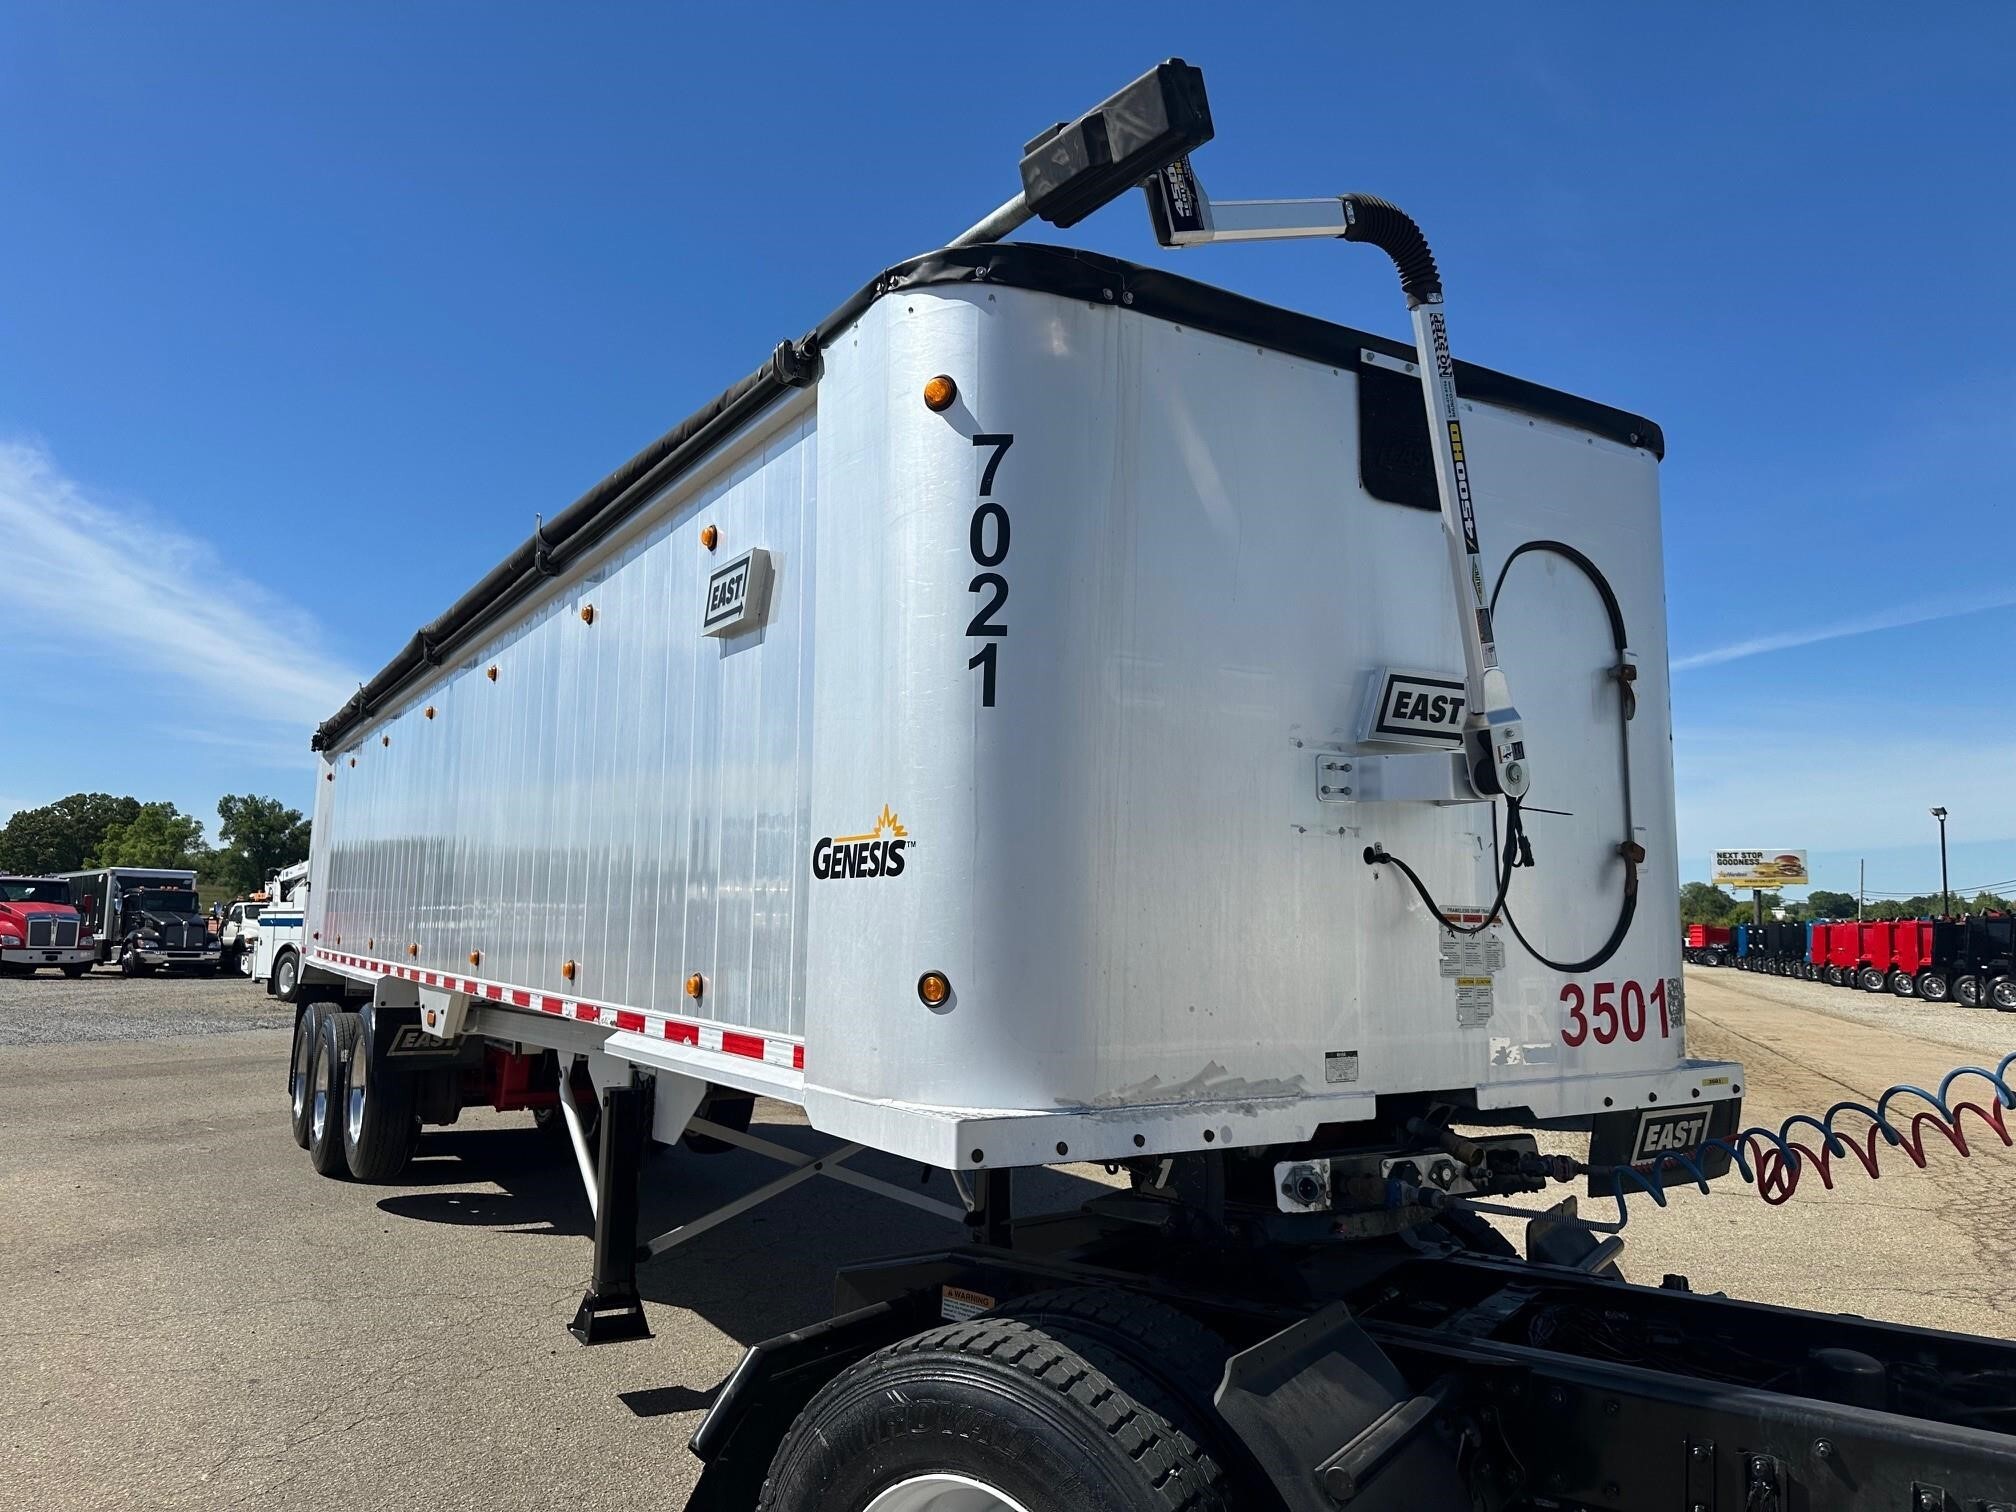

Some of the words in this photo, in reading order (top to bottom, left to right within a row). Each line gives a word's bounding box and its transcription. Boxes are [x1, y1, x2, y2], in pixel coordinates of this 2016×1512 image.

[1433, 314, 1446, 351] STEP
[1440, 354, 1450, 376] NO
[1450, 423, 1474, 539] 4500HD
[710, 573, 743, 612] EAST
[1392, 691, 1465, 724] EAST
[1560, 978, 1668, 1047] 3501
[1643, 1119, 1703, 1152] EAST
[954, 1290, 989, 1306] WARNING
